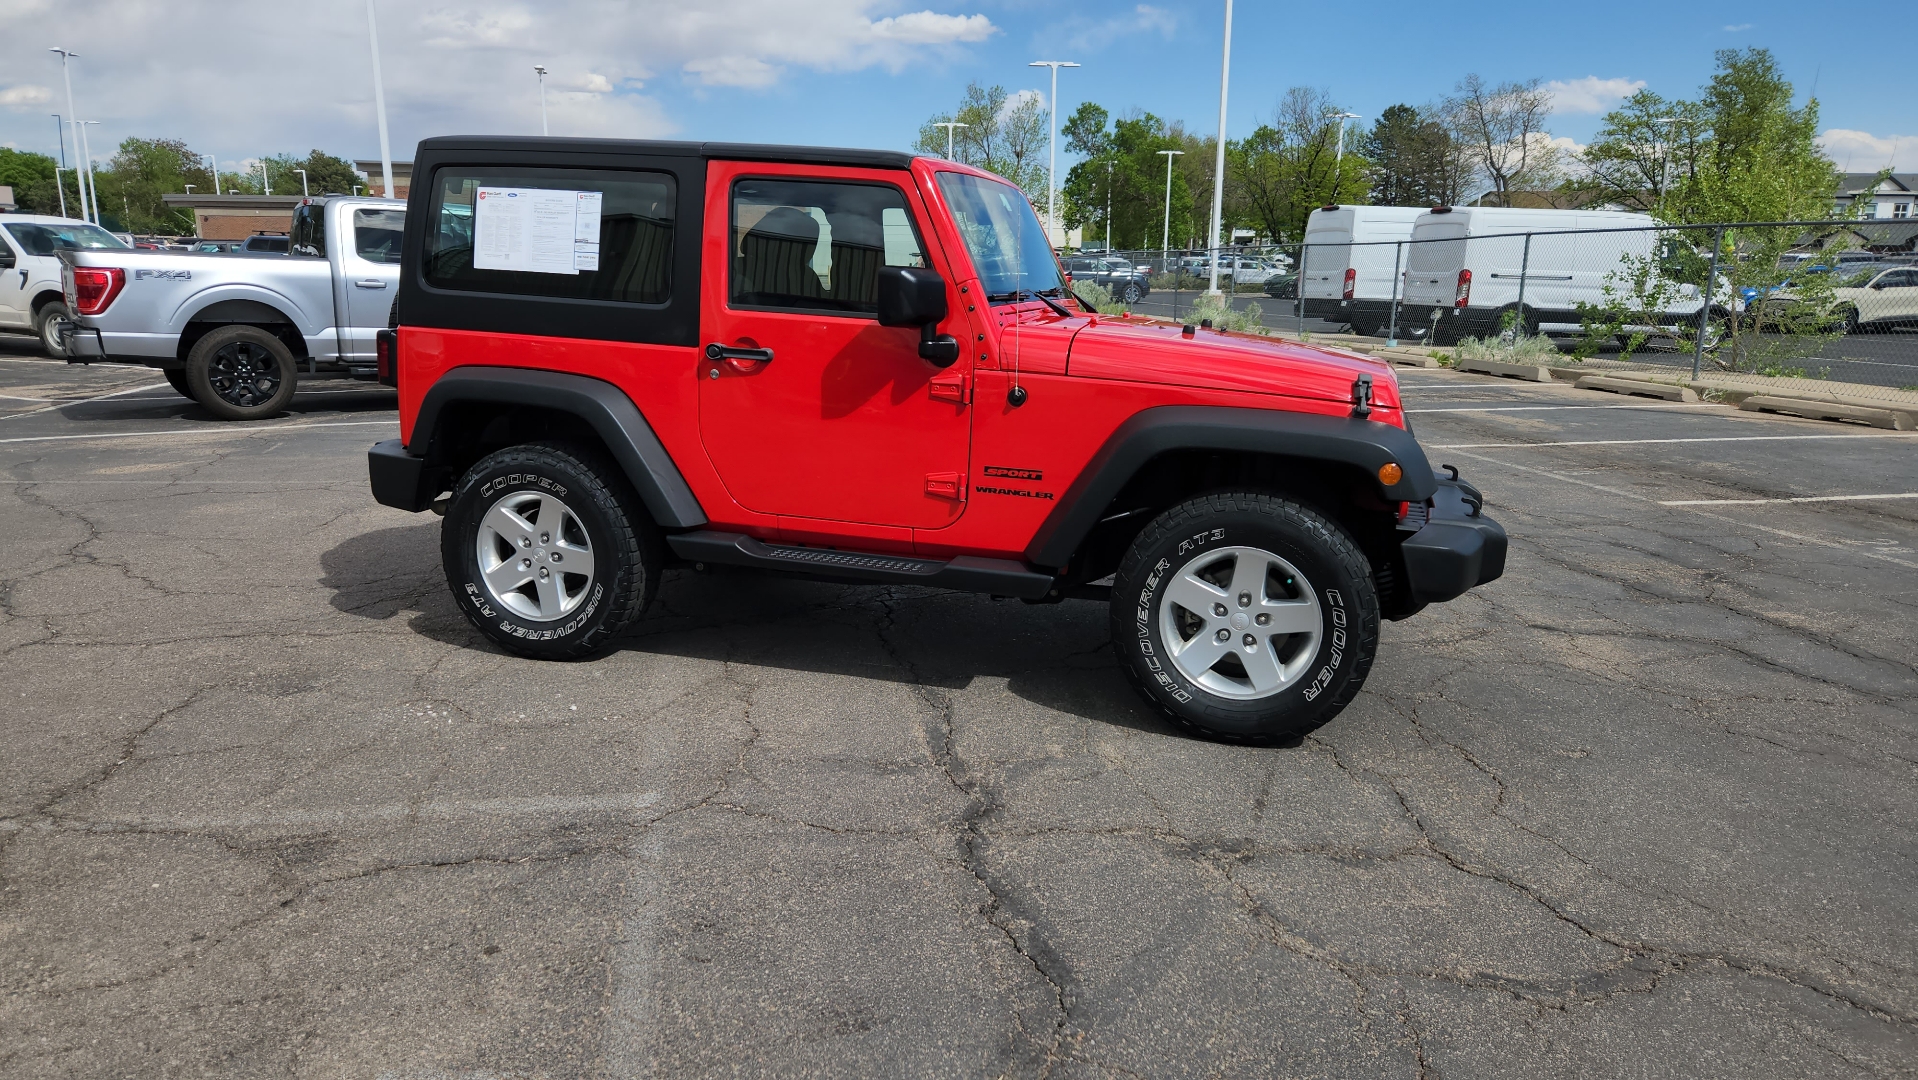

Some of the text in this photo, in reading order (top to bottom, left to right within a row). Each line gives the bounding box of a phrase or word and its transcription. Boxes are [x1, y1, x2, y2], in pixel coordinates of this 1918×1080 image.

[135, 269, 191, 280] FX4
[480, 473, 568, 498] COOPER
[986, 467, 1040, 479] SPORT
[976, 486, 1054, 500] WRANGLER
[464, 582, 604, 641] DISCOVERER AT3
[1136, 528, 1225, 704] DISCOVERER AT3
[1302, 588, 1347, 702] COOPER
